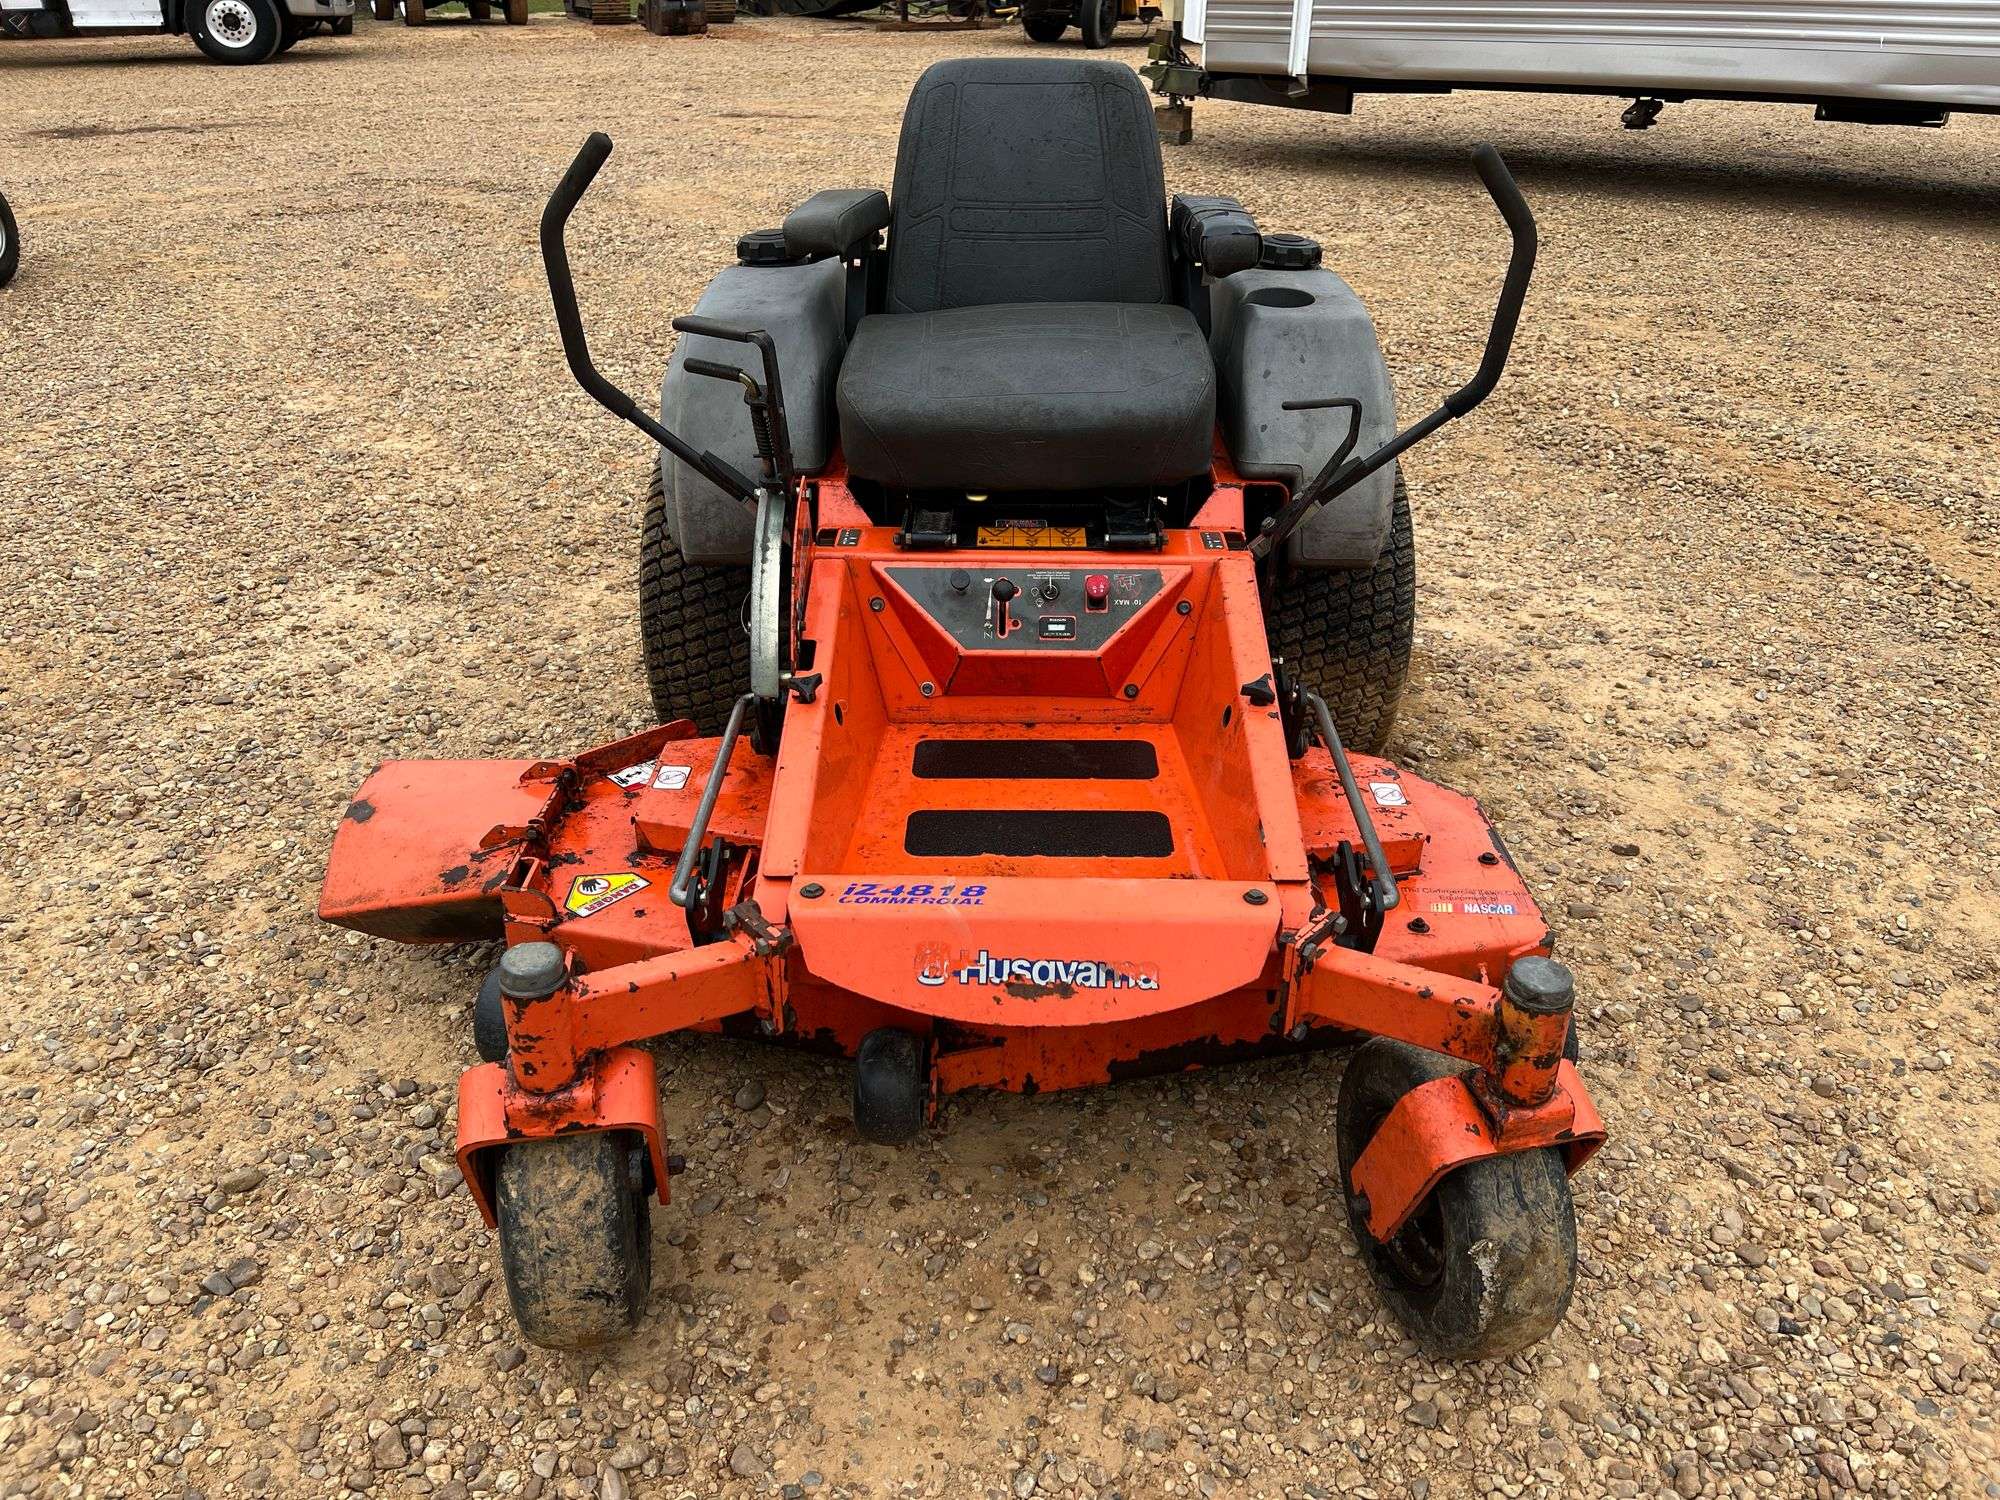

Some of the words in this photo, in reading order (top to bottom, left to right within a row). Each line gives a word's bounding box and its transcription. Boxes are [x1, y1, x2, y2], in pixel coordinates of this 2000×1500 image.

[844, 883, 988, 897] iZ4818
[584, 883, 640, 912] DANGER
[838, 896, 984, 905] COMMERCIAL
[1464, 903, 1513, 914] NASCAR
[957, 949, 1160, 990] Husqvarna
